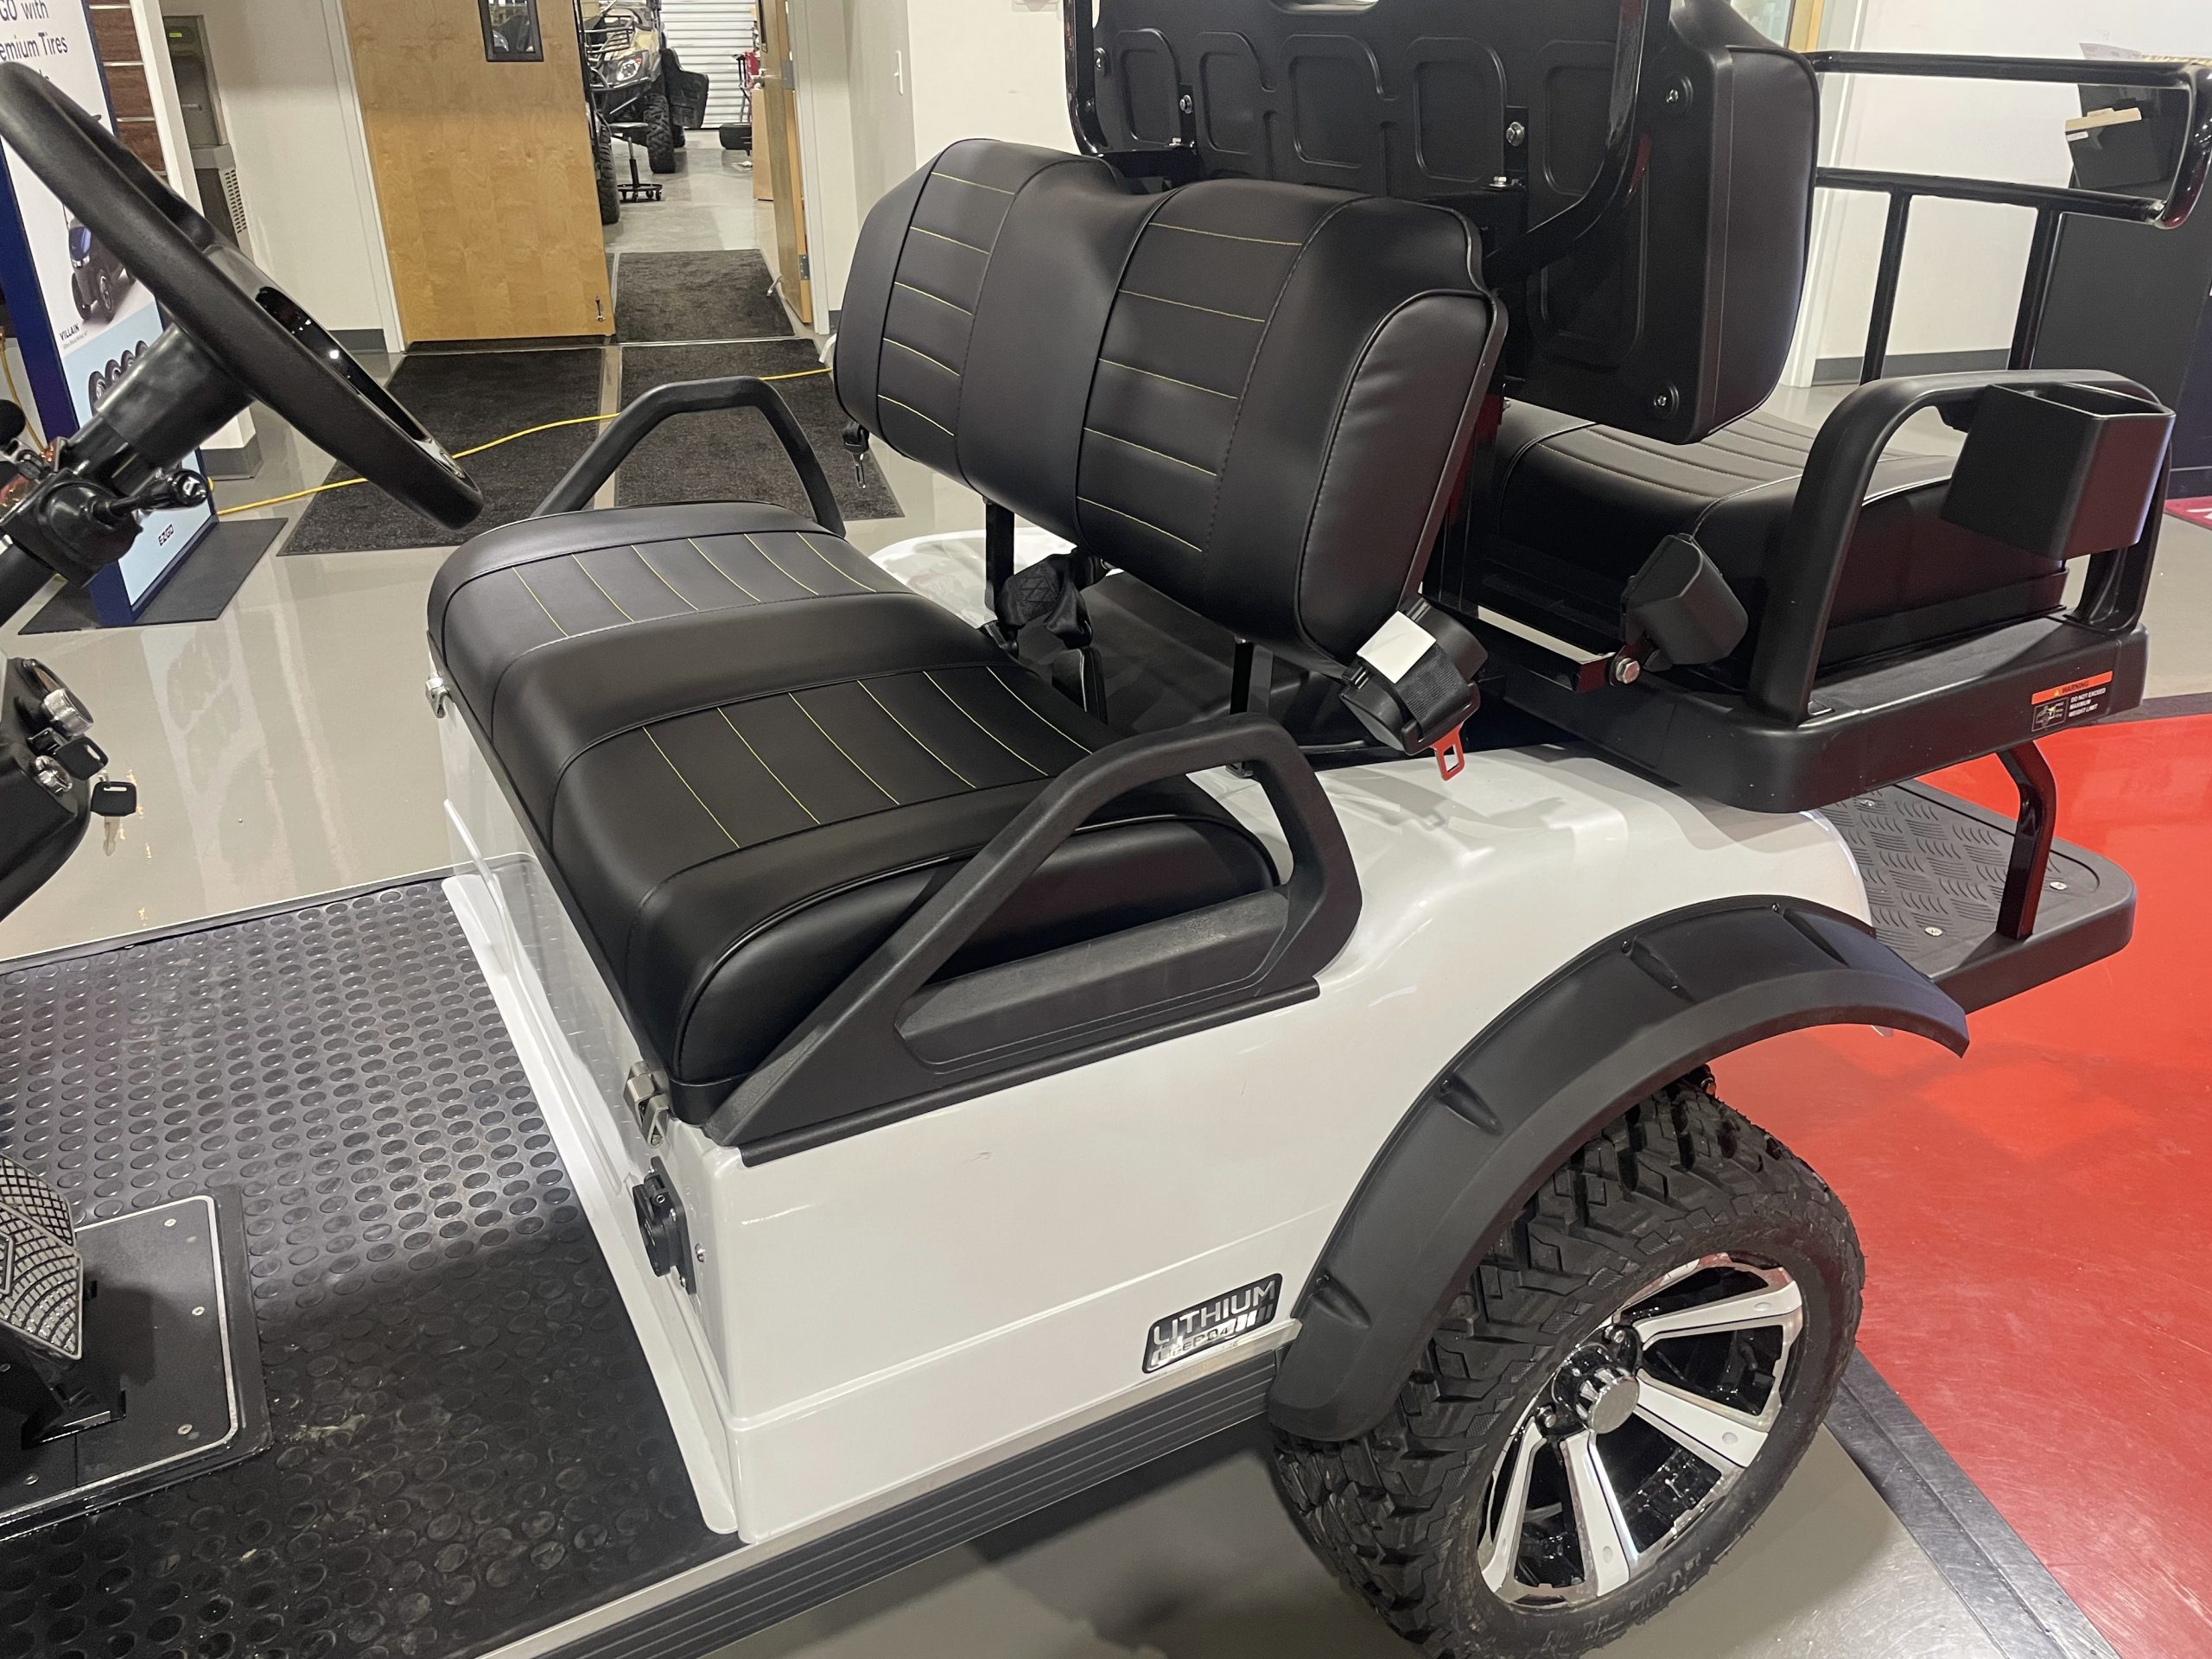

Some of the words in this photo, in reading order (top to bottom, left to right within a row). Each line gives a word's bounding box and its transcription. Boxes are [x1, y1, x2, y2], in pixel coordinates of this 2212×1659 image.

[21, 0, 48, 20] with
[38, 31, 68, 55] Tires
[59, 323, 79, 340] VILLAIN
[1154, 1281, 1275, 1345] LITHIUM
